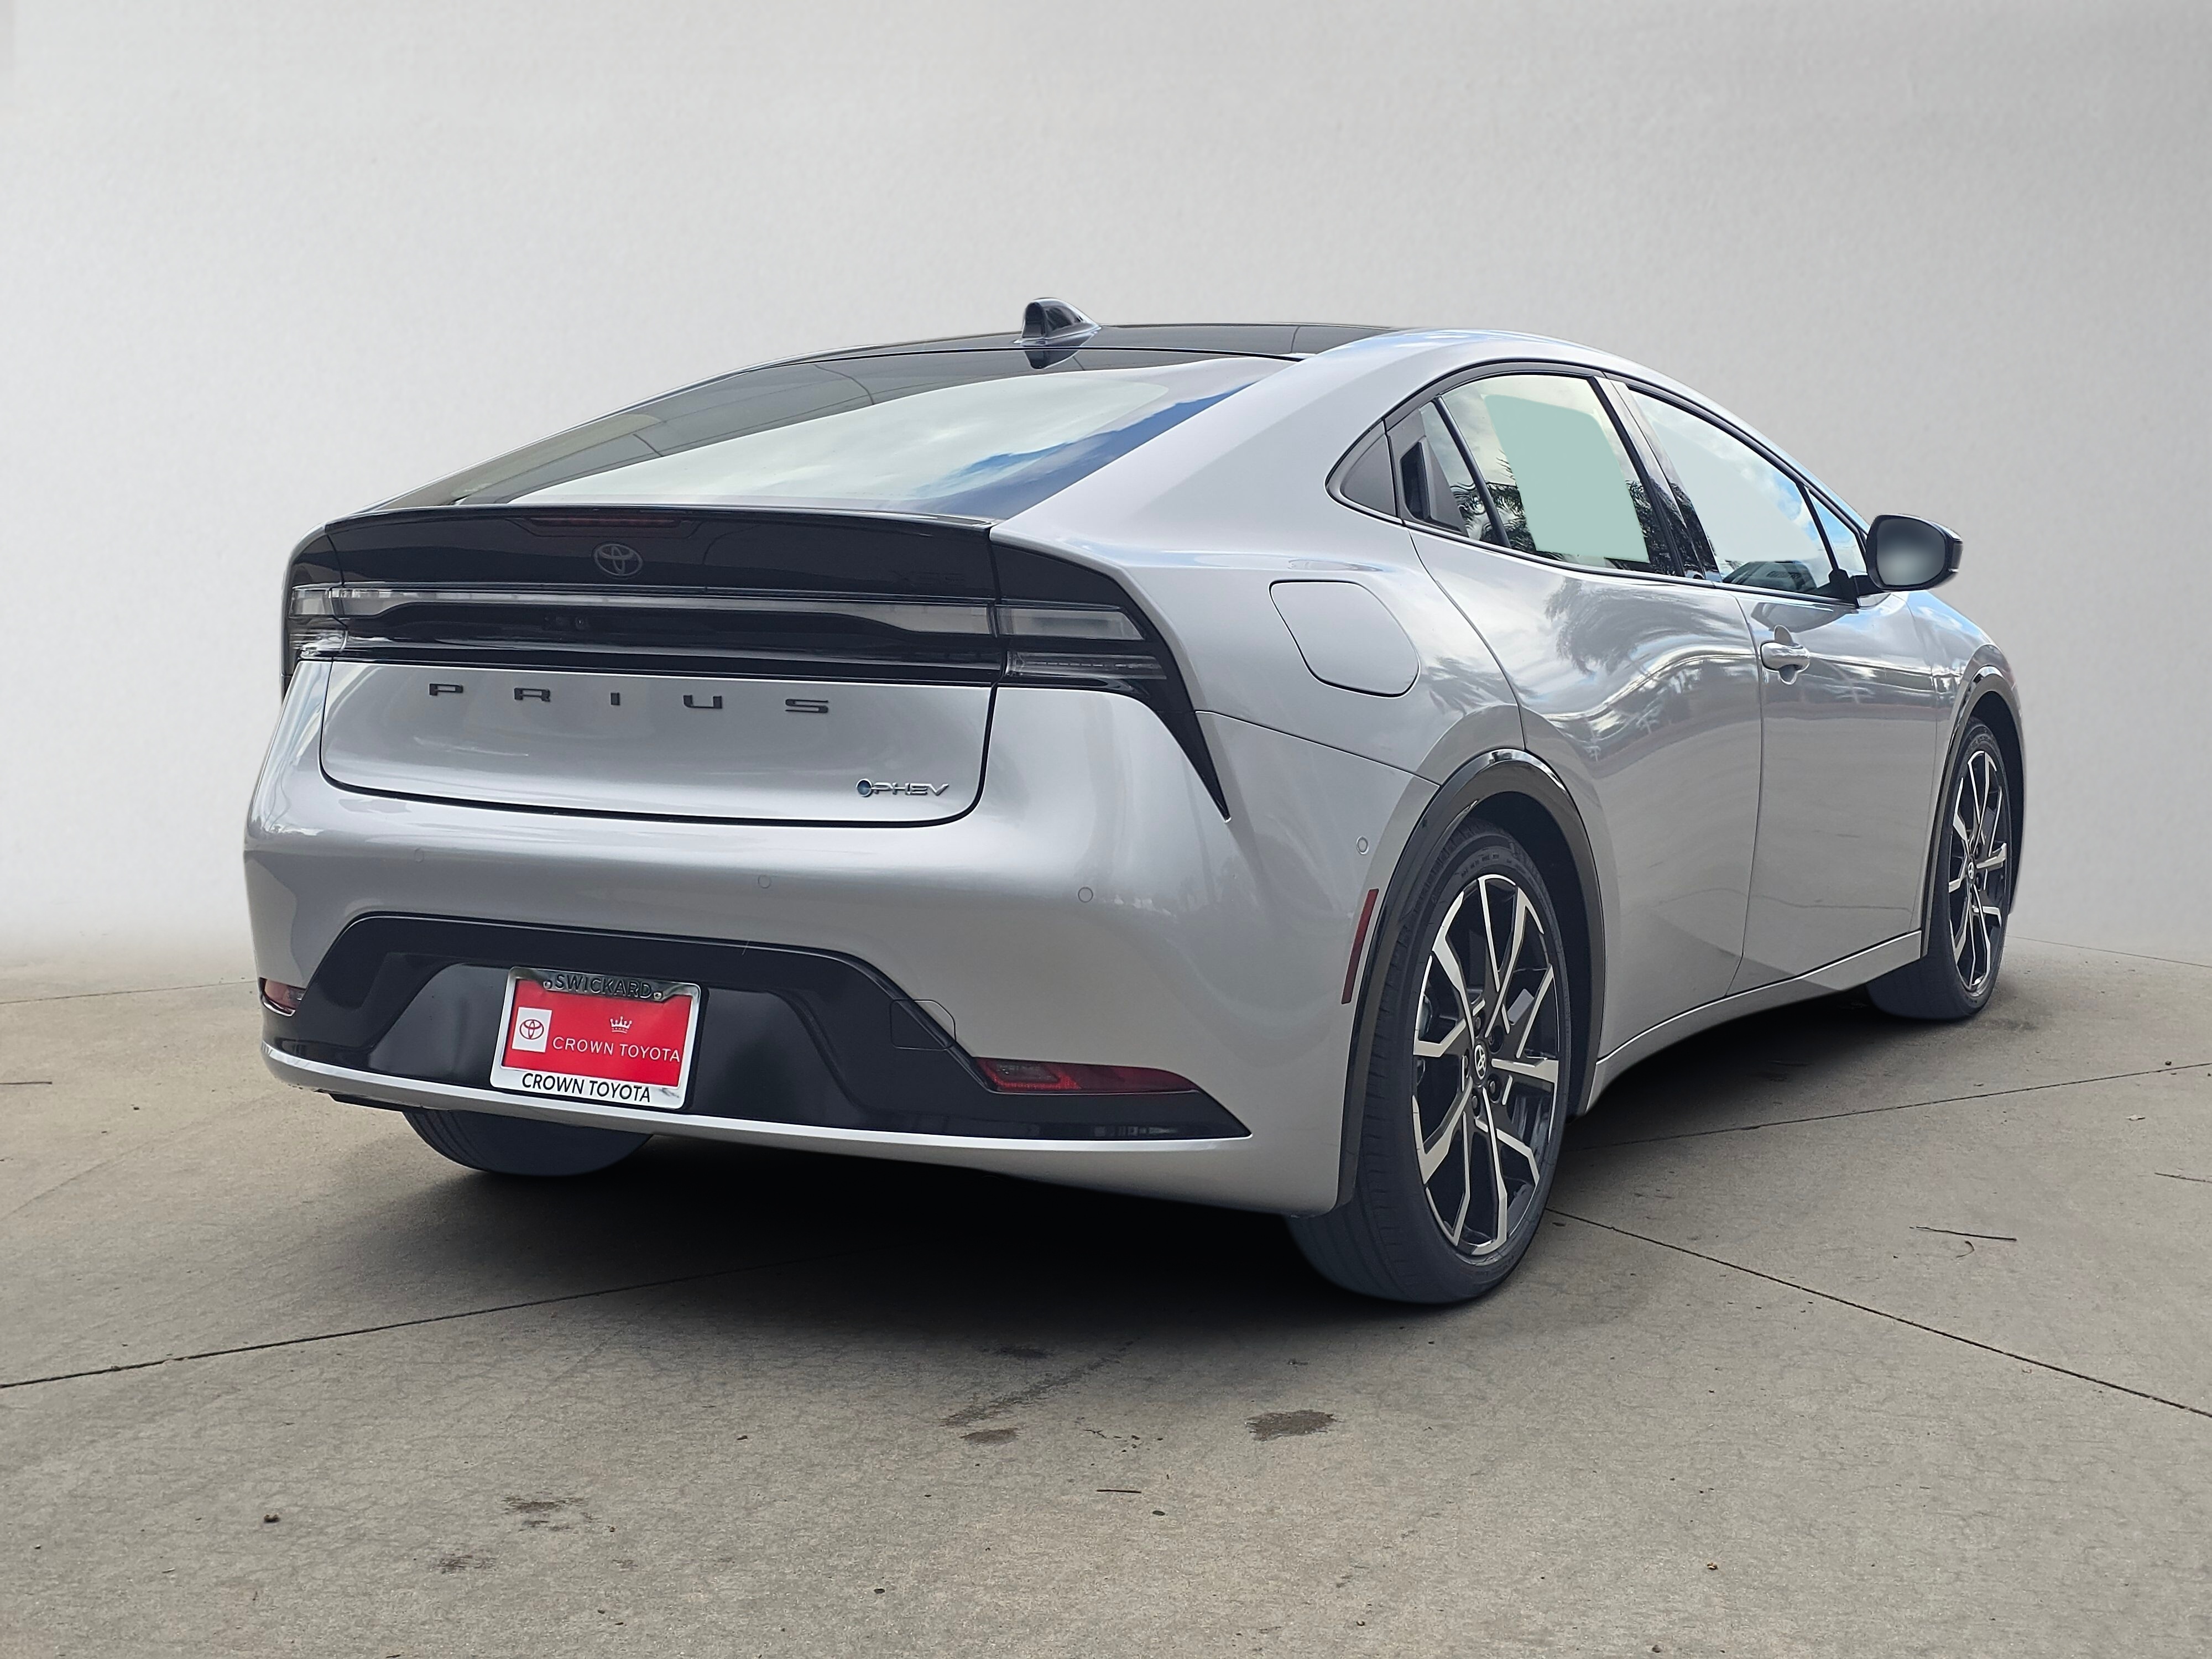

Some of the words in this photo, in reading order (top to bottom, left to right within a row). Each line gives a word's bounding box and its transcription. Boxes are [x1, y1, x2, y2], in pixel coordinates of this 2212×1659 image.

[429, 683, 829, 713] PRIUS
[555, 974, 653, 999] SWICKARD
[552, 1036, 614, 1055] CROWN
[619, 1044, 681, 1063] TOYOTA
[522, 1072, 585, 1095] CROWN
[589, 1080, 651, 1103] TOYOTA
